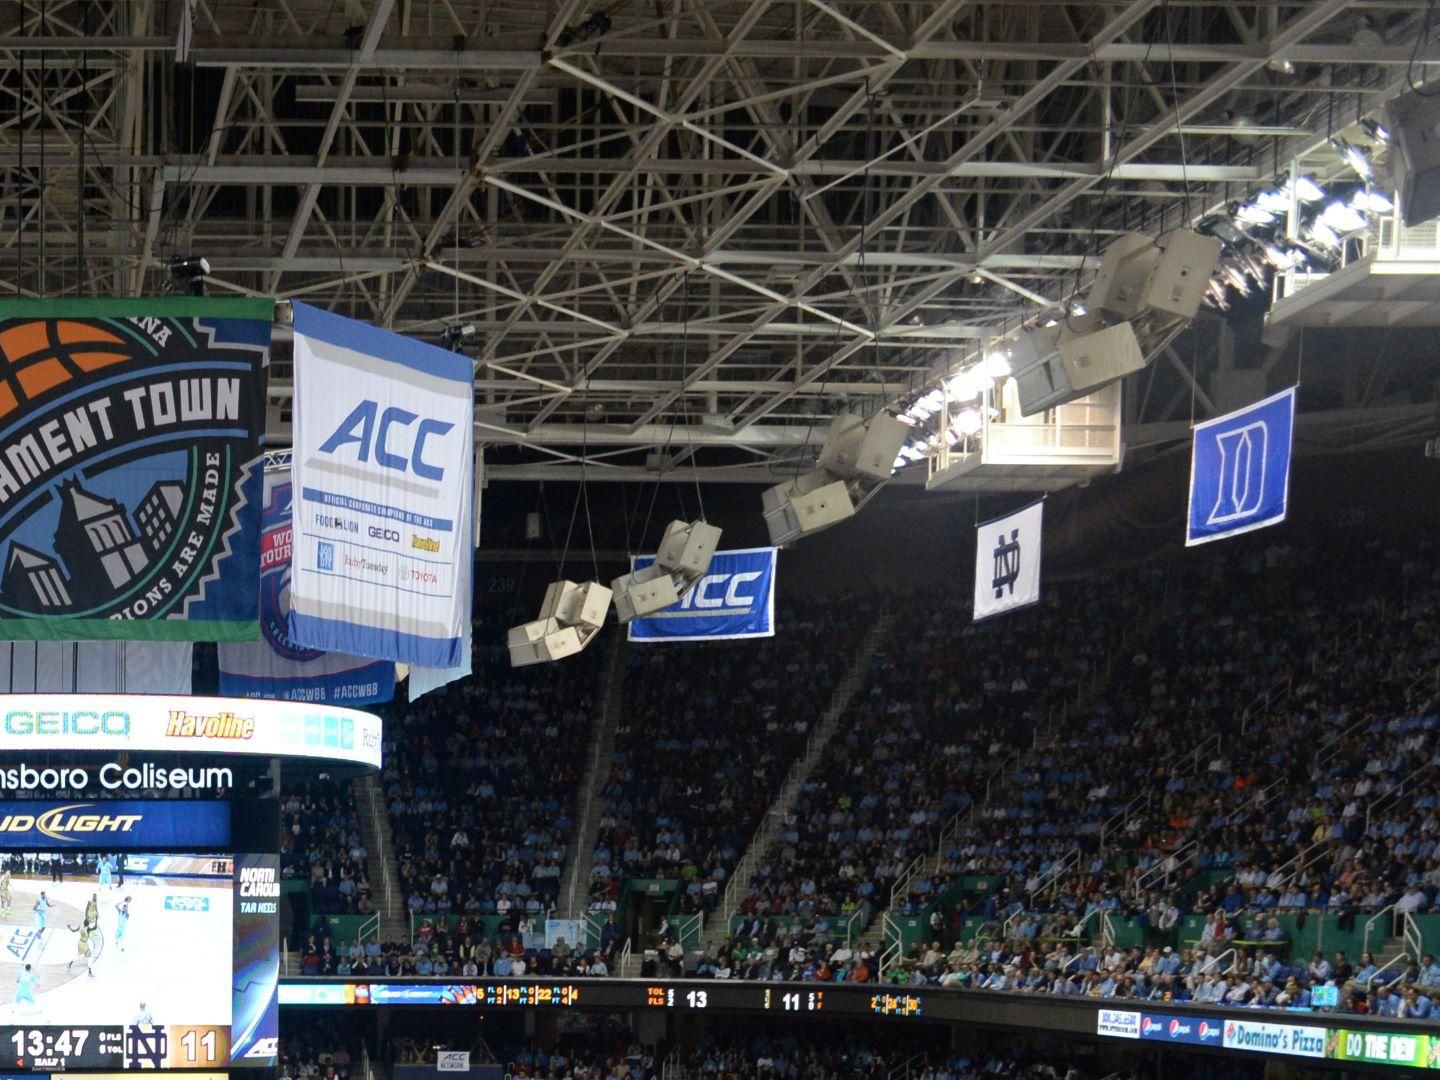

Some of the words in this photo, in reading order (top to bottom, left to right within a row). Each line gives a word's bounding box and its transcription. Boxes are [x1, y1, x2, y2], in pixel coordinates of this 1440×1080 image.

[125, 377, 240, 430] TOWN
[318, 399, 456, 482] ACC
[196, 451, 221, 524] MADE
[411, 570, 438, 584] TOYOTA
[334, 682, 378, 699] #ACCWBB
[4, 711, 131, 735] GEICO
[166, 711, 256, 740] Havoline
[99, 763, 233, 790] Coliseum
[48, 814, 144, 832] LIGHT
[240, 868, 275, 882] NORTH
[507, 988, 519, 1000] 13
[539, 988, 552, 1000] 22
[648, 988, 664, 996] TOL
[648, 997, 664, 1005] FLS
[687, 991, 707, 1008] 13
[783, 993, 800, 1011] 11
[12, 1030, 89, 1056] 13:47
[181, 1030, 216, 1061] 11
[1237, 1026, 1288, 1050] Domino's
[1292, 1030, 1323, 1052] Pizza
[1346, 1035, 1361, 1057] DO
[1364, 1035, 1387, 1060] THE
[107, 1046, 123, 1054] TOL
[442, 1053, 466, 1061] ACC
